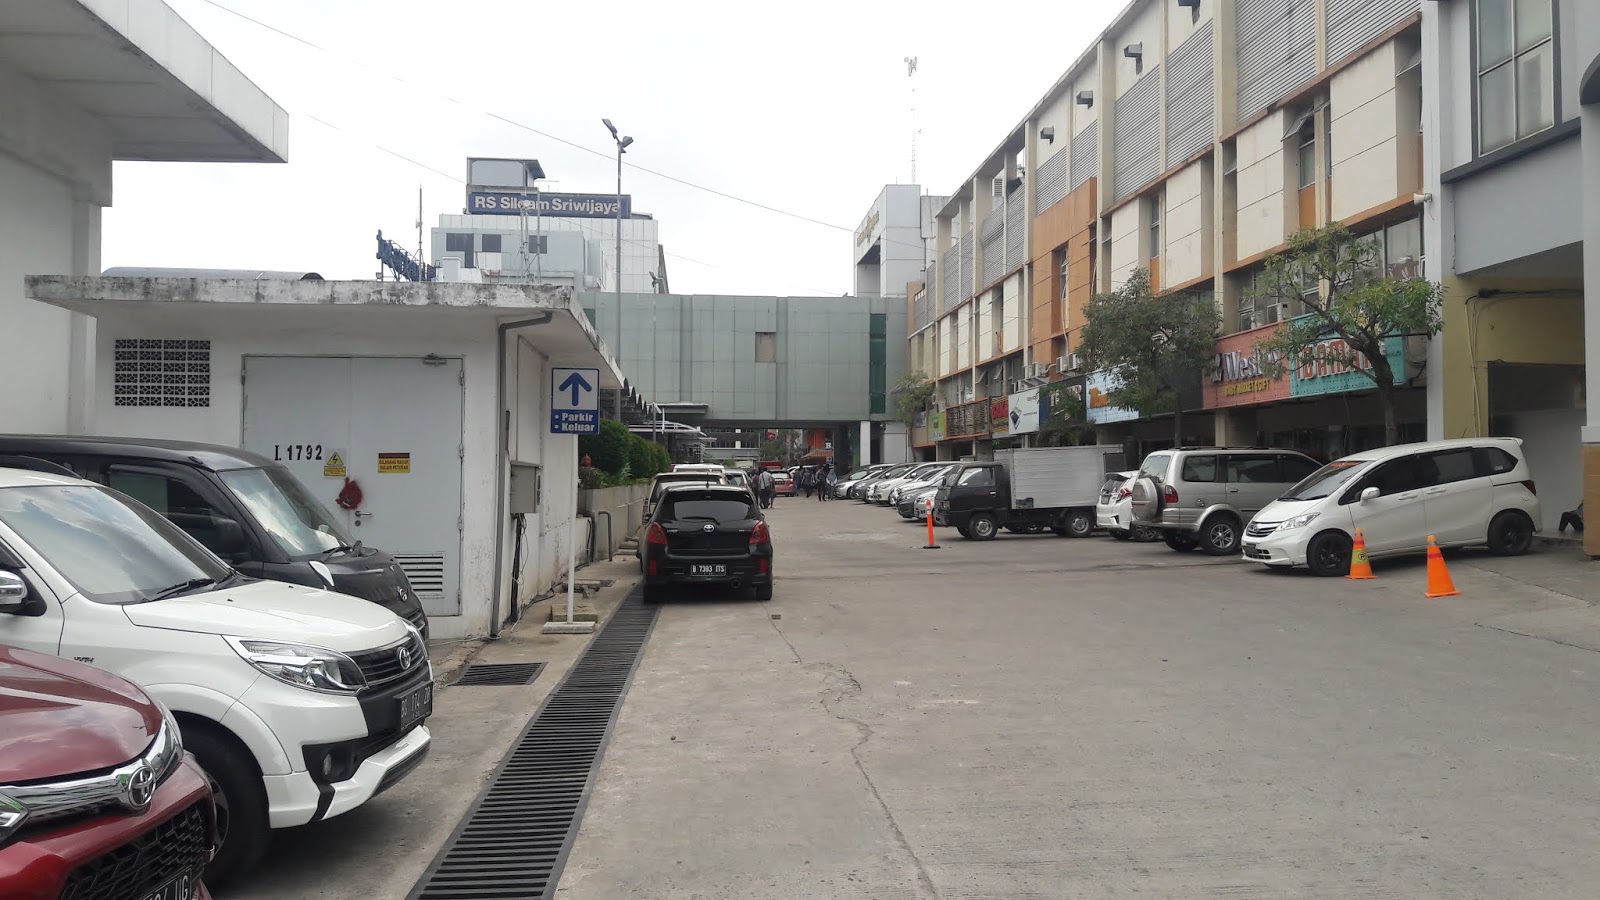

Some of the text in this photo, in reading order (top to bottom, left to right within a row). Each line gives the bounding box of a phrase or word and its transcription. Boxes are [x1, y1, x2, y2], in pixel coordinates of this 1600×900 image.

[475, 195, 496, 209] RS
[552, 198, 620, 215] Sriwijaya
[561, 412, 593, 421] Parkir
[561, 422, 595, 431] Keluar
[692, 565, 697, 573] B
[715, 565, 725, 573] ITS
